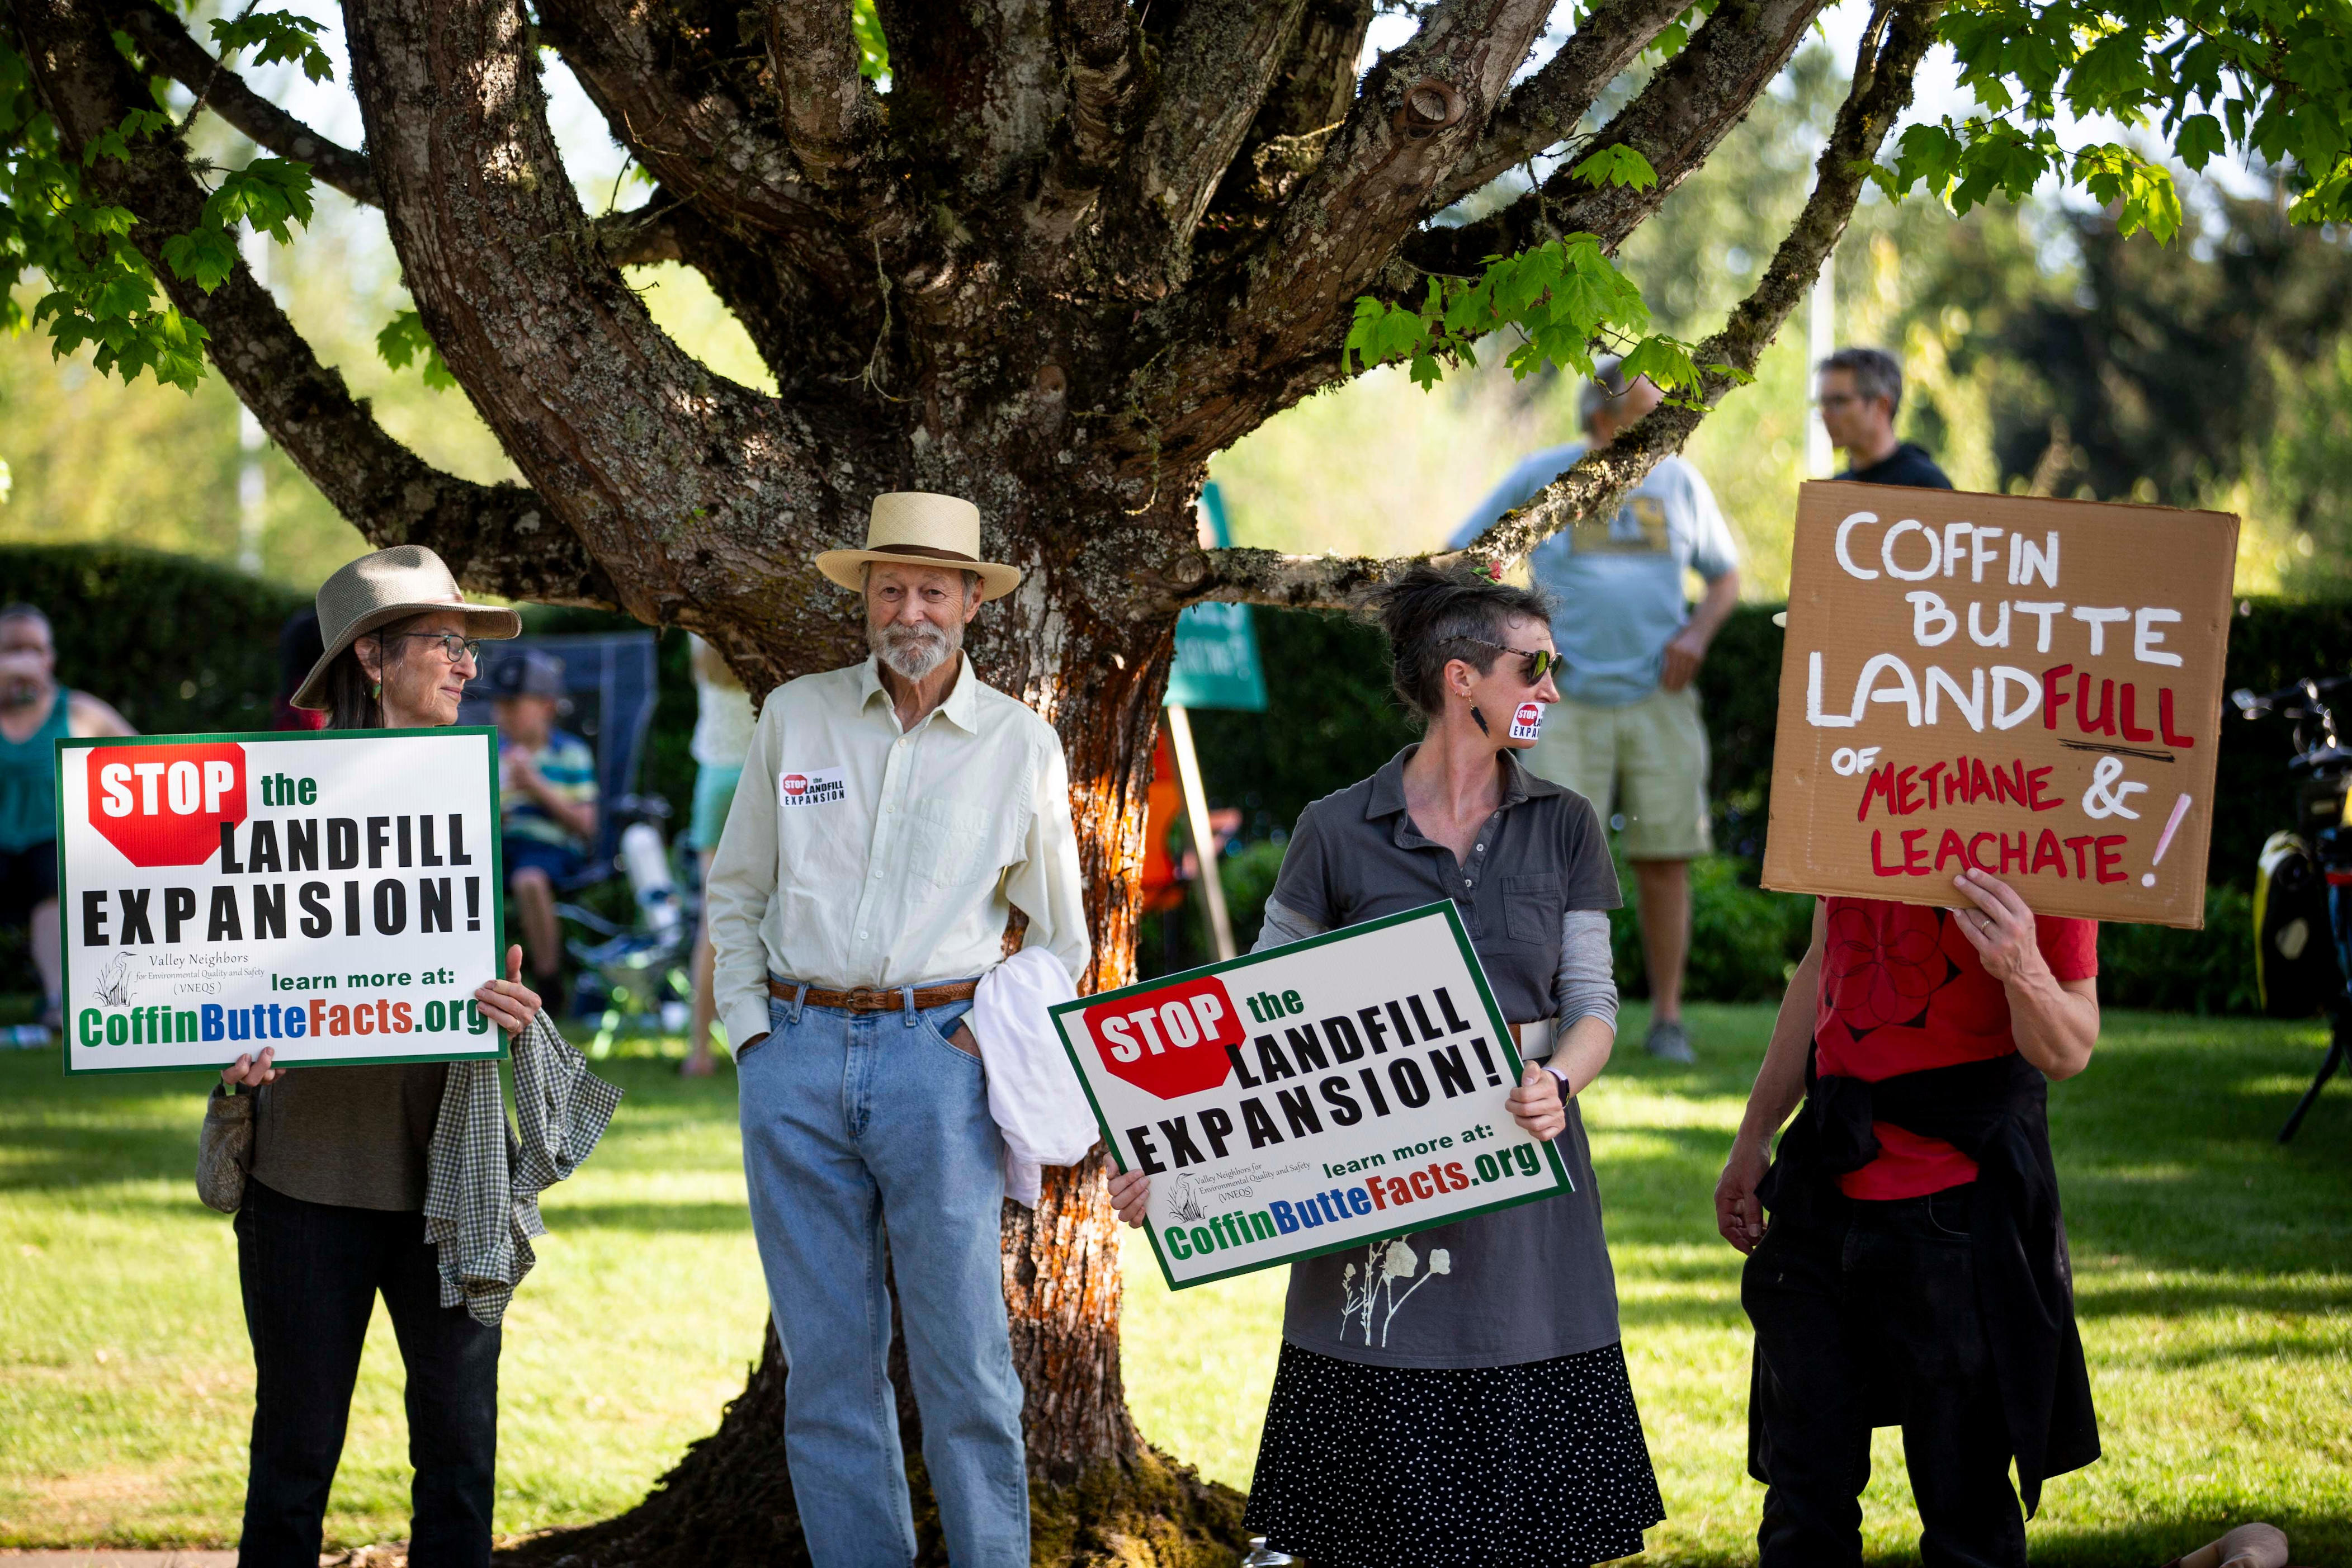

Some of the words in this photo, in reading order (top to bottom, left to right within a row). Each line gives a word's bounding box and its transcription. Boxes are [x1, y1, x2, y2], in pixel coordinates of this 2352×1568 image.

[1835, 512, 2058, 588] COFFIN
[1905, 591, 2183, 667] BUTTE
[1518, 710, 1537, 720] STOP
[1806, 651, 2195, 748] LANDFULL
[101, 761, 234, 818] STOP
[261, 773, 317, 807] the
[785, 780, 807, 789] STOP
[785, 790, 844, 805] EXPANSION
[805, 781, 843, 794] LANDFILL
[1831, 747, 1881, 776] OF
[1858, 755, 2065, 822] METHANE
[2082, 756, 2148, 820] &
[220, 814, 471, 874] LANDFILL
[82, 876, 481, 947] EXPANSION!
[135, 972, 147, 983] for
[148, 970, 200, 979] Environmental
[201, 968, 227, 980] Quality
[229, 968, 242, 976] and
[244, 967, 265, 979] Safety
[149, 954, 185, 969] Valley
[190, 952, 249, 967] Neighbors
[272, 974, 337, 990] learn
[348, 972, 412, 988] more
[422, 967, 454, 985] at:
[79, 999, 488, 1048] CoffinButteFacts.org
[1101, 993, 1224, 1063] STOP
[1246, 985, 1304, 1024] the
[1224, 987, 1471, 1089] LANDFILL
[1126, 1036, 1503, 1176] EXPANSION!
[1194, 1176, 1216, 1186] Valley
[1216, 1166, 1251, 1179] Neighbors
[1250, 1163, 1262, 1174] for
[1199, 1178, 1249, 1194] Environmental
[1249, 1170, 1274, 1183] Quality
[1276, 1165, 1289, 1175] and
[1290, 1161, 1310, 1172] Safety
[1323, 1154, 1386, 1178] learn
[1392, 1136, 1453, 1161] more
[1461, 1123, 1494, 1143] at:
[1163, 1142, 1541, 1261] CoffinButteFacts.org
[1218, 1186, 1253, 1203] (VNEQS)
